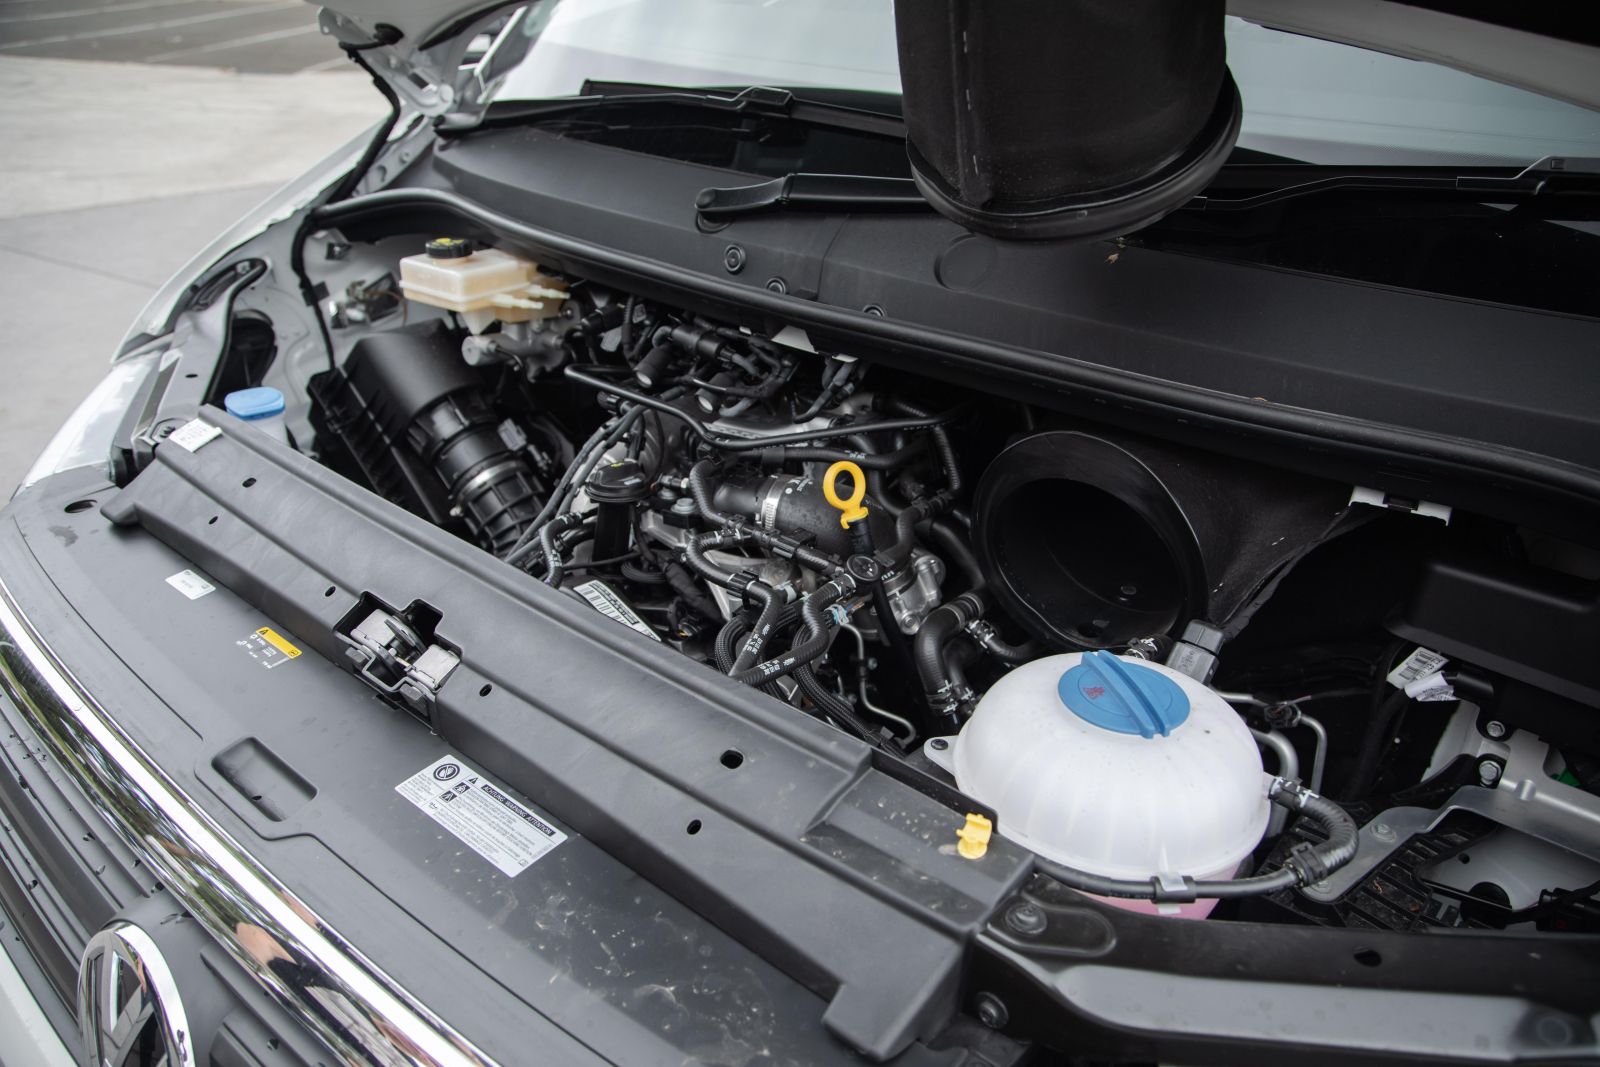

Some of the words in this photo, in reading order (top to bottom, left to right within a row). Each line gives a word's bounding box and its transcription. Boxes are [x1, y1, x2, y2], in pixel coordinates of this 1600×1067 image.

[482, 786, 504, 802] ACHTUNG
[504, 800, 527, 817] WARNING
[527, 815, 552, 834] ATTENTION
